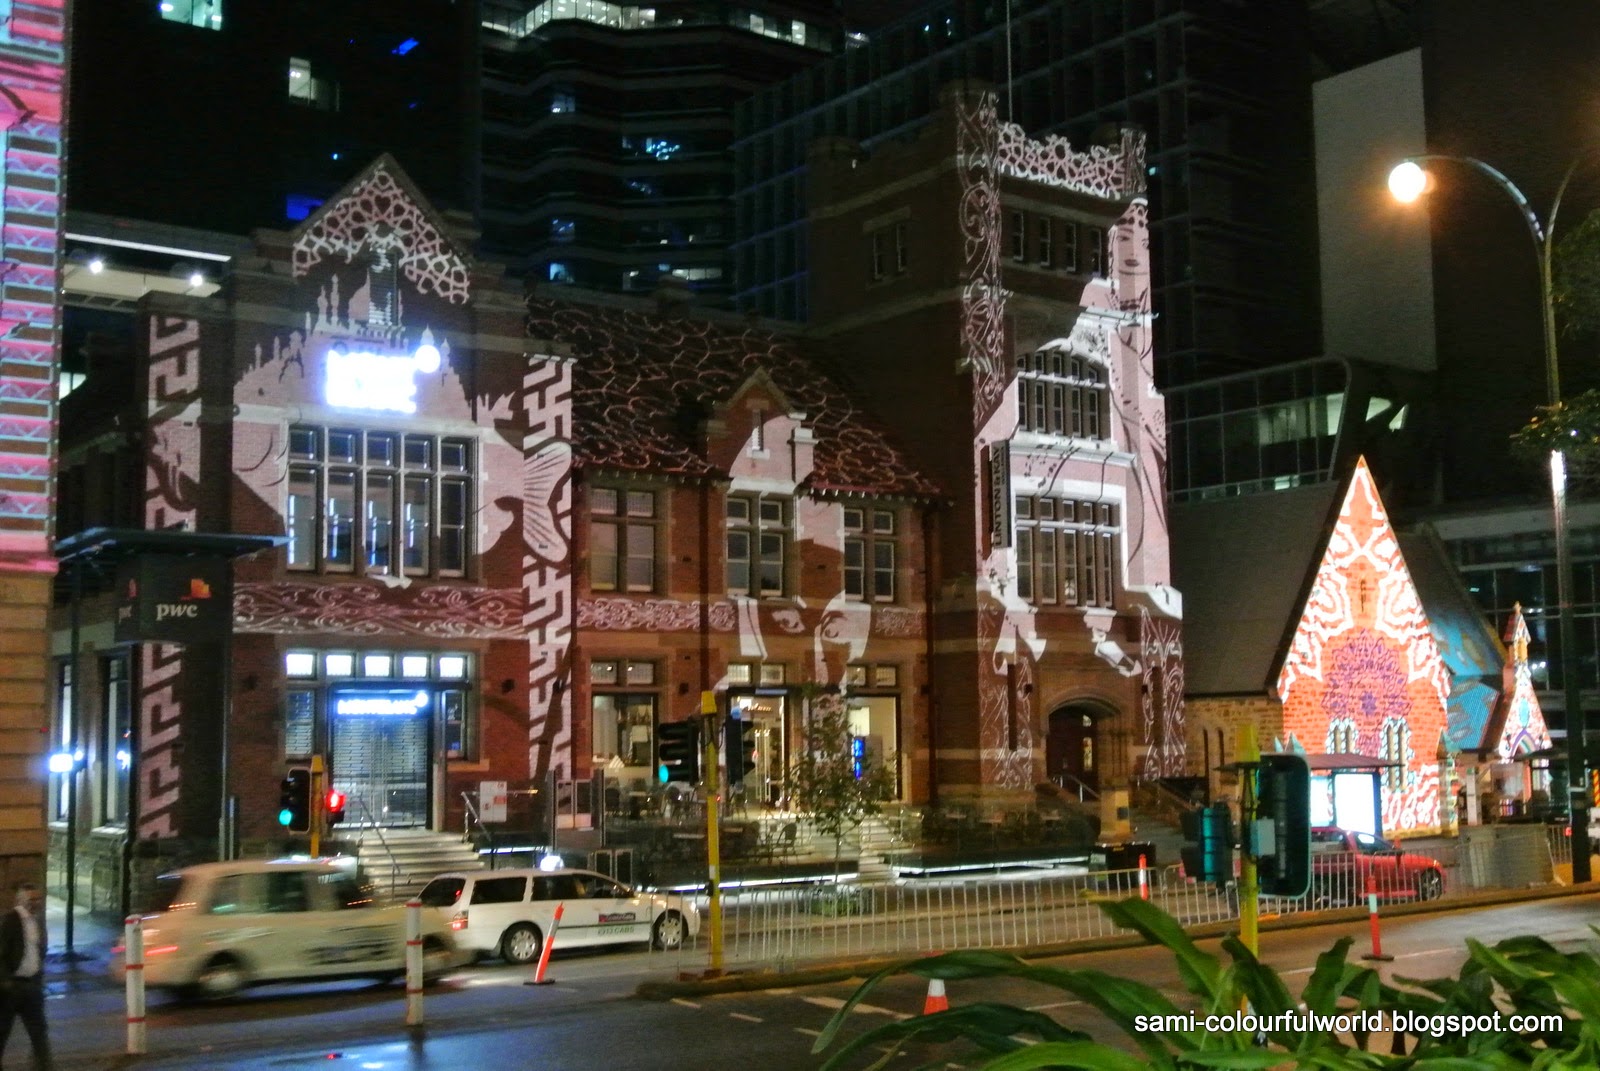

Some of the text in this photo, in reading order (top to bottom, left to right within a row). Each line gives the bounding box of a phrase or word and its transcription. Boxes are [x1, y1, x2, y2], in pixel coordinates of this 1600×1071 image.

[994, 477, 1001, 486] &
[994, 488, 1002, 546] LINTON
[156, 603, 198, 620] pwc
